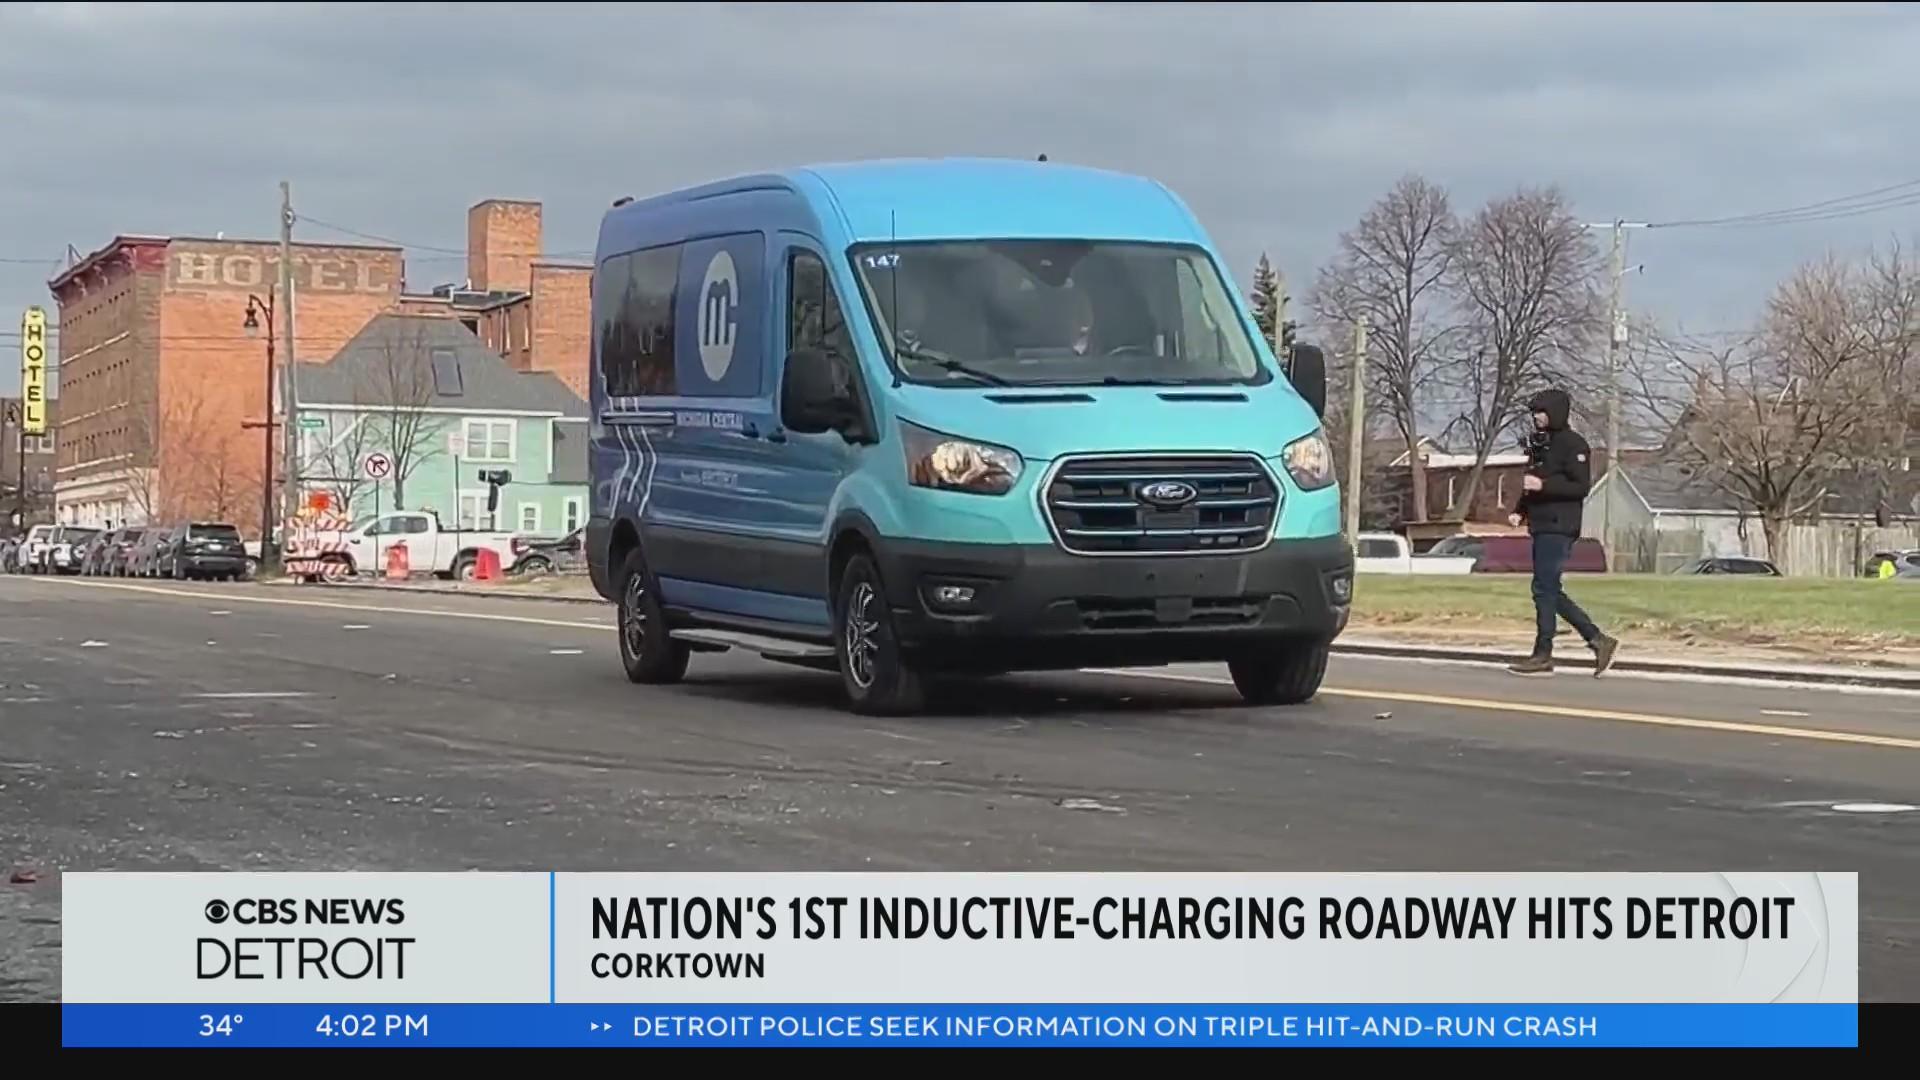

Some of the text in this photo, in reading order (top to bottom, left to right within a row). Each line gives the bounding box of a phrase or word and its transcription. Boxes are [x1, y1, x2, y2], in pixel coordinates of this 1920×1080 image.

[175, 252, 391, 293] HOTEL
[866, 255, 900, 268] 147
[26, 324, 43, 422] HOTEL
